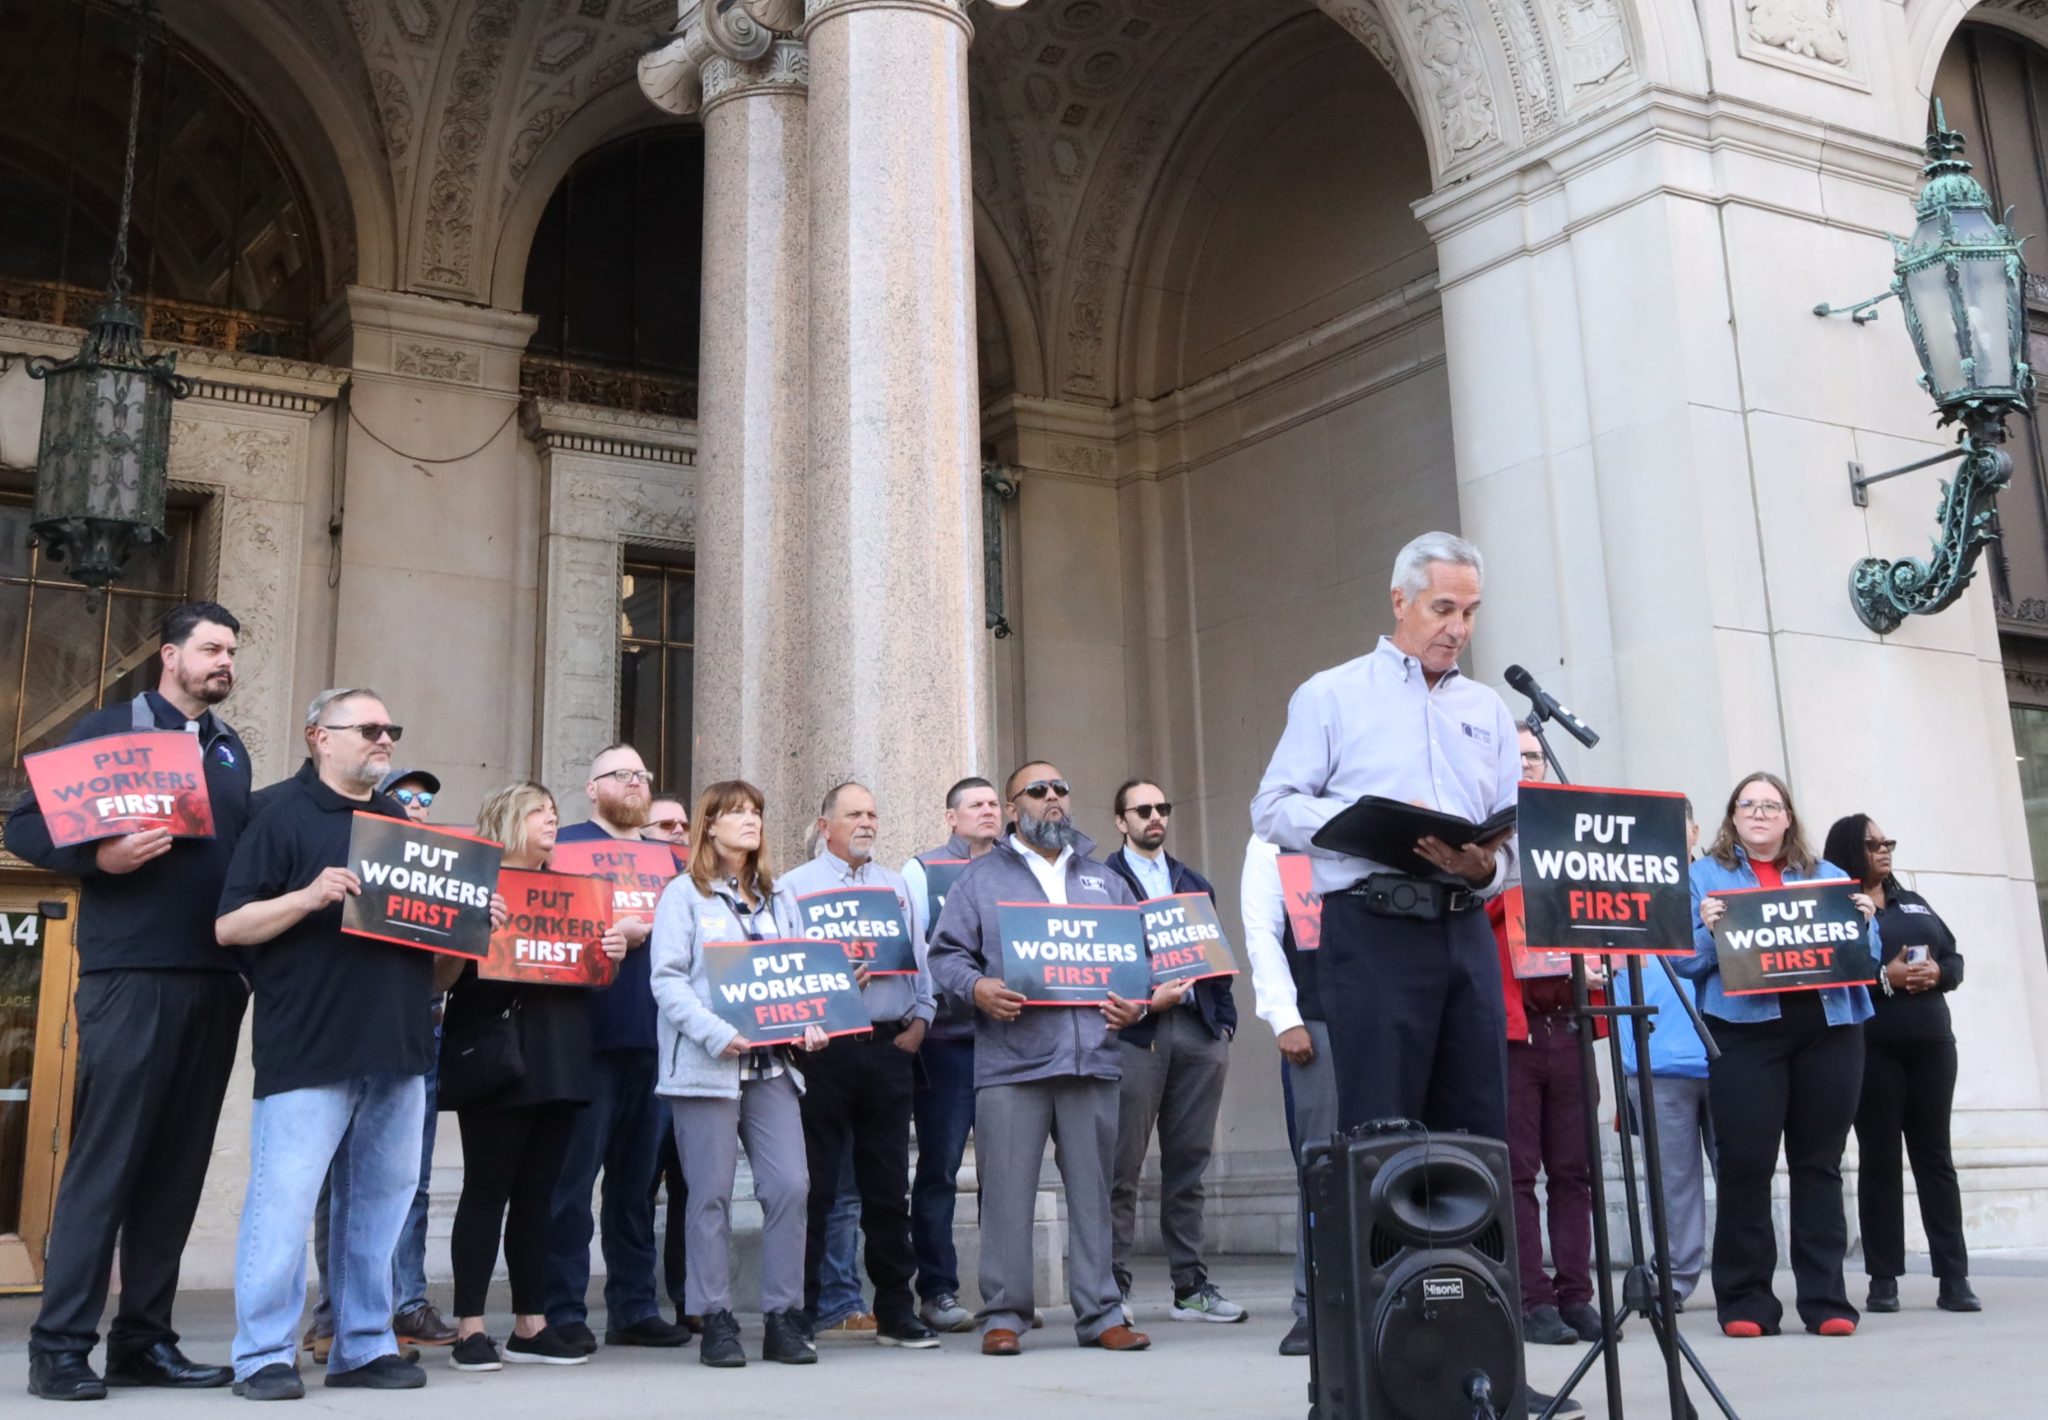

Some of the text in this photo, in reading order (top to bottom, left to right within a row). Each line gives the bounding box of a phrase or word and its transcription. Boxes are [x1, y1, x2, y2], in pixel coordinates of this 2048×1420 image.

[93, 748, 153, 770] PUT
[52, 771, 197, 802] WORKERS
[96, 794, 175, 817] FIRST
[1575, 813, 1636, 844] PUT
[404, 841, 459, 872] PUT
[592, 852, 636, 869] PUT
[1531, 849, 1680, 885] WORKERS
[361, 860, 489, 908] WORKERS
[386, 895, 459, 929] FIRST
[526, 889, 574, 912] PUT
[612, 891, 656, 908] RST
[808, 900, 860, 922] PUT
[1568, 890, 1651, 921] FIRST
[1761, 900, 1817, 923] PUT
[804, 919, 900, 941] ORKERS
[1047, 918, 1098, 939] PUT
[1144, 907, 1185, 930] PUT
[1146, 923, 1219, 951] ORKERS
[1725, 920, 1860, 950] WORKERS
[515, 938, 582, 963] FIRST
[1012, 941, 1138, 962] WORKERS
[1151, 944, 1205, 971] FIRST
[1760, 947, 1834, 972] FIRST
[752, 953, 806, 977] PUT
[1043, 965, 1112, 985] FIRST
[719, 973, 851, 1004] WORKERS
[754, 997, 828, 1025] FIRST
